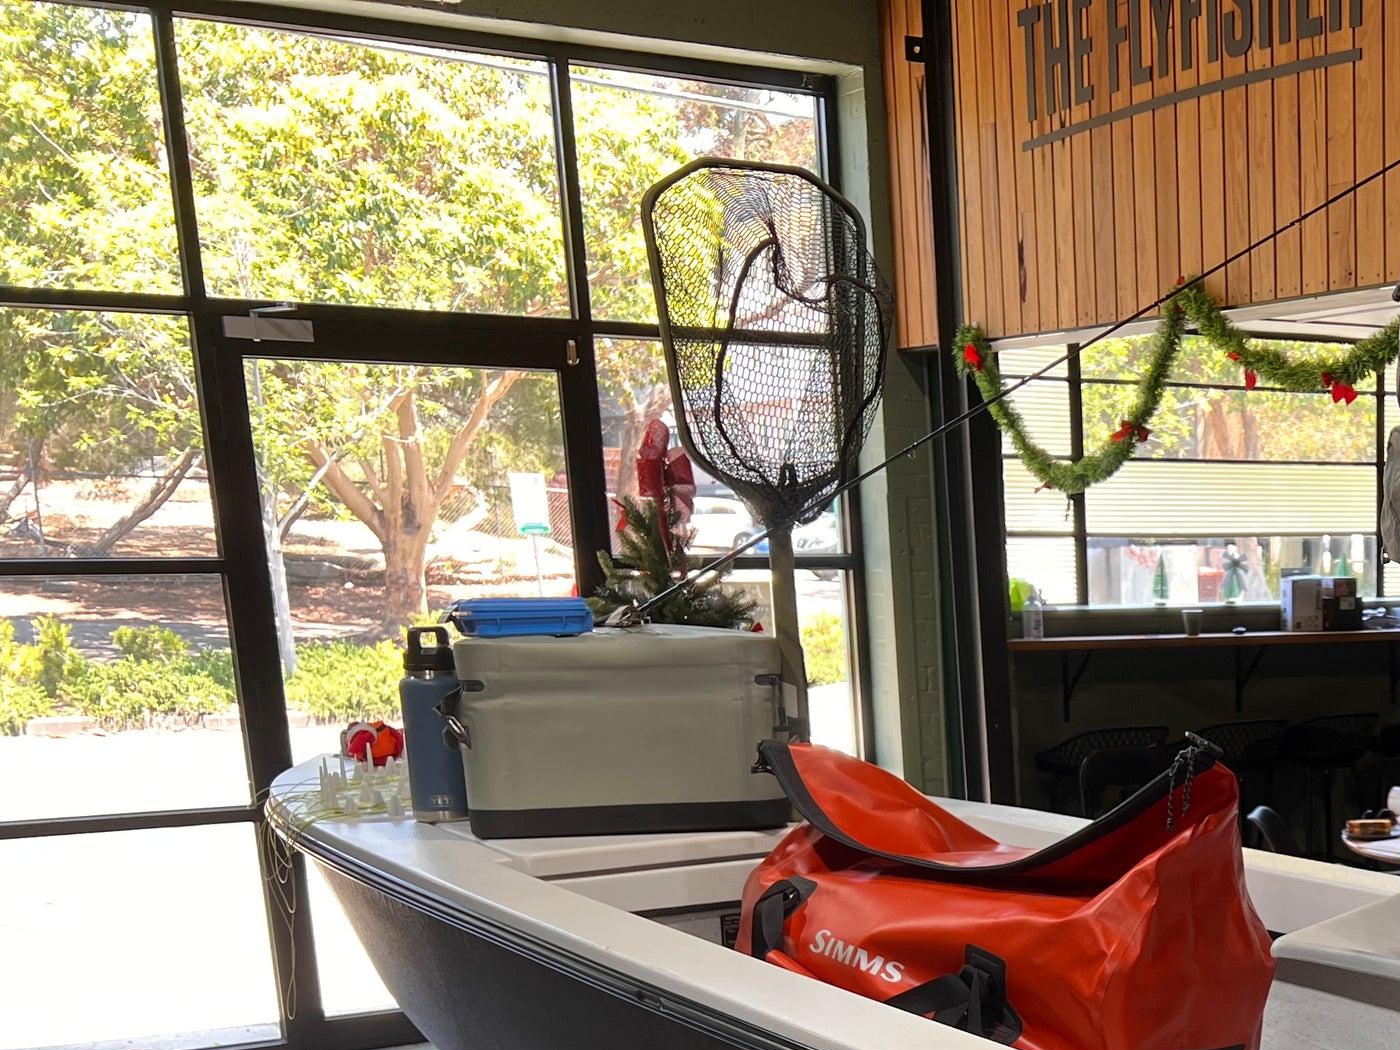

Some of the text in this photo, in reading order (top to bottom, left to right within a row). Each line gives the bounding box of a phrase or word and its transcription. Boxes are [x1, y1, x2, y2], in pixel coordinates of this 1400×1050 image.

[1017, 0, 1363, 123] THE FLYFIS
[809, 928, 906, 983] SIMMS
